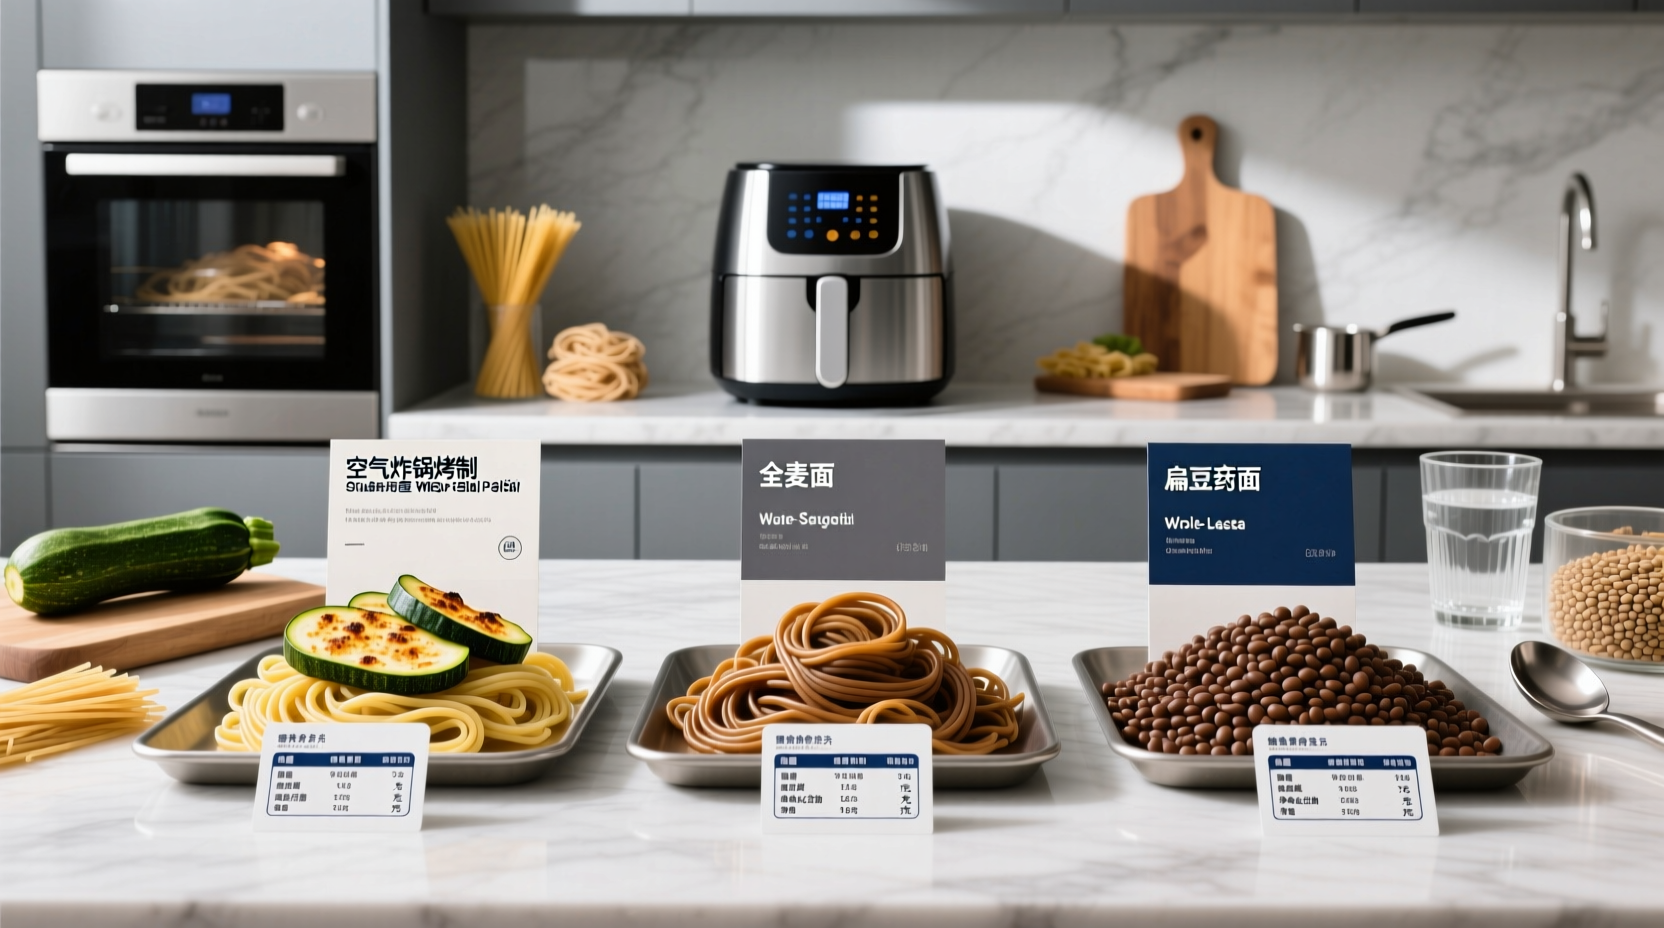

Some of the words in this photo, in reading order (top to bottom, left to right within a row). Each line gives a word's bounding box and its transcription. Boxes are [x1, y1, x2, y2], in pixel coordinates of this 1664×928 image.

[346, 456, 478, 480] 空气炸锅烤制
[759, 461, 835, 488] 全麦面
